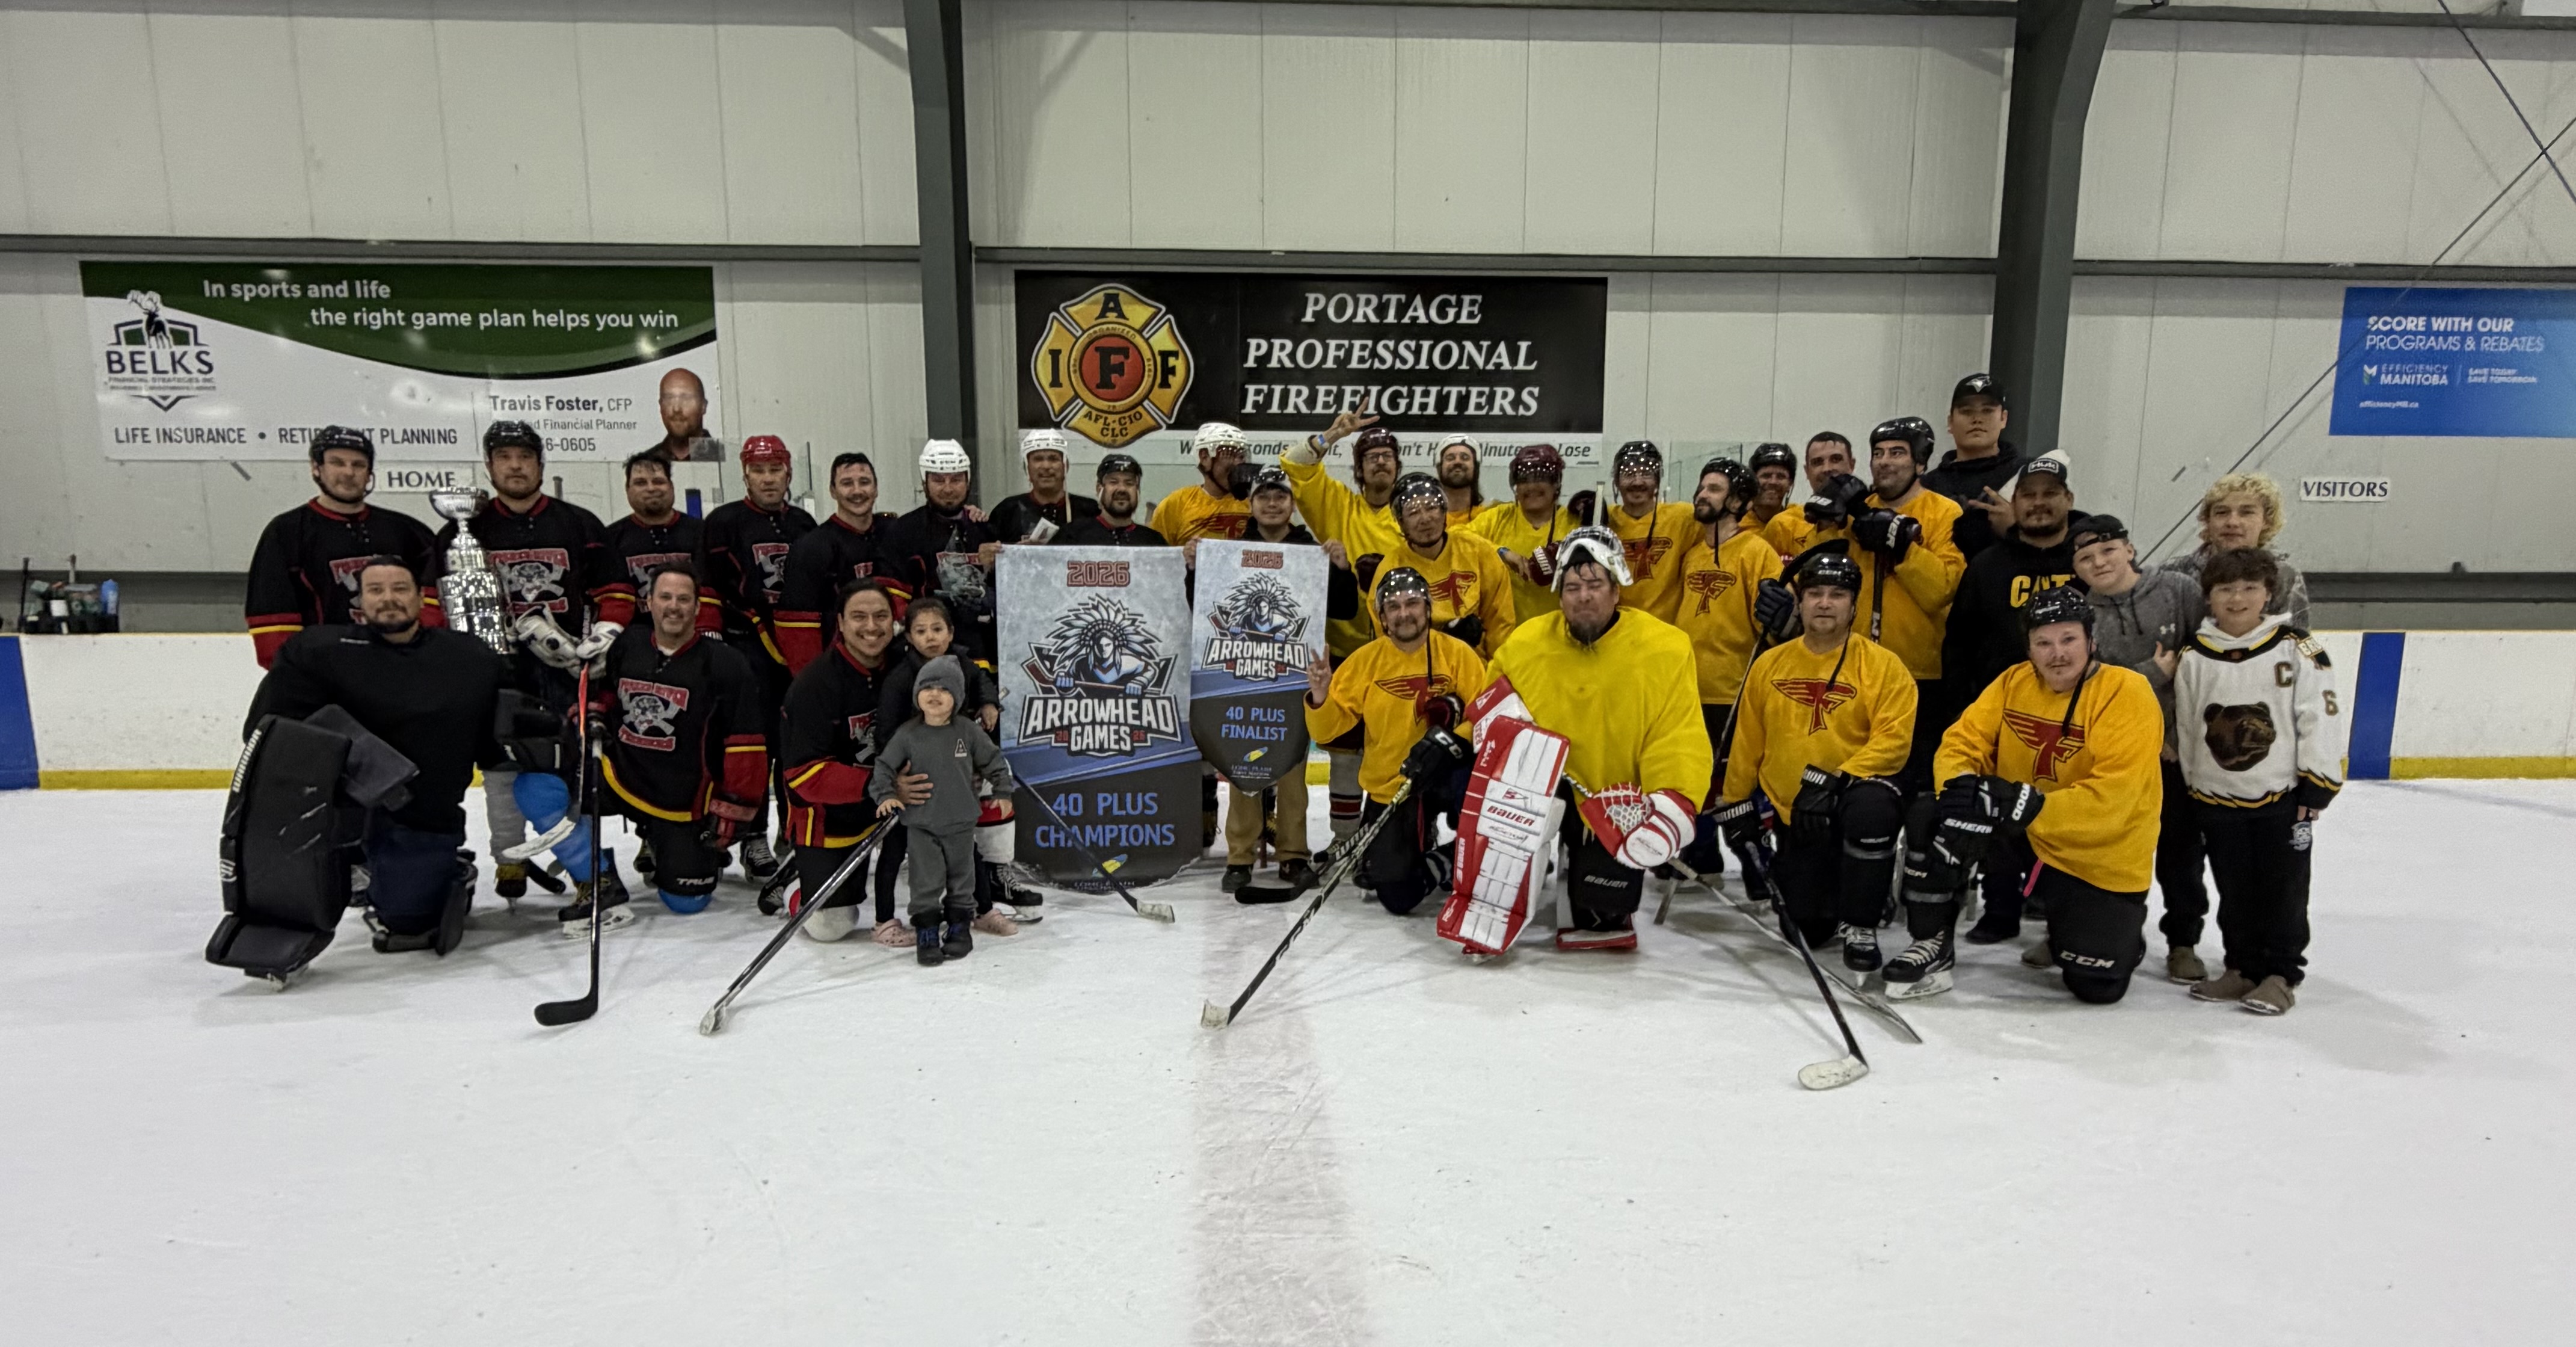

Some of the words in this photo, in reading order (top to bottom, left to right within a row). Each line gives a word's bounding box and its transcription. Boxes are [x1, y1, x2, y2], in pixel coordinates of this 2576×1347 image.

[204, 280, 224, 298] In
[232, 281, 301, 301] sports
[307, 280, 349, 298] and
[355, 280, 391, 298] life
[1095, 293, 1130, 321] A
[1302, 292, 1483, 324] PORTAGE
[311, 308, 347, 325] the
[354, 308, 405, 330] right
[411, 312, 472, 330] game
[479, 309, 526, 330] plan
[533, 309, 590, 331] helps
[595, 313, 635, 331] you
[640, 310, 678, 327] win
[2367, 316, 2426, 331] SCORE
[2432, 316, 2473, 332] WITH
[2477, 317, 2515, 333] OUR
[2365, 334, 2461, 351] PROGRAMS
[2465, 336, 2476, 351] &
[2480, 336, 2544, 353] REBATES
[106, 350, 214, 375] BELKS
[1243, 338, 1539, 371] PROFESSIONAL
[1048, 349, 1063, 388] I
[1095, 347, 1130, 389] F
[1158, 350, 1179, 389] F
[2381, 363, 2448, 373] EFFICIENCY
[2379, 374, 2448, 386] MANITOBA
[490, 395, 541, 411] Travis
[545, 395, 604, 413] Foster,
[608, 398, 633, 411] CFP
[1240, 383, 1540, 417] FIREFIGHTERS
[543, 418, 593, 430] Financial
[595, 419, 637, 430] Planner
[1100, 427, 1129, 438] CLC
[114, 428, 152, 444] LIFE
[157, 428, 247, 445] INSURANCE
[380, 429, 458, 445] PLANNING
[387, 471, 456, 489] HOME
[2303, 481, 2388, 498] VISITORS
[1241, 549, 1283, 570] 2026
[1067, 560, 1131, 587] 2026
[1209, 640, 1307, 670] ARROWHEAD
[1235, 659, 1276, 679] GAMES
[2273, 661, 2293, 688] C
[2322, 689, 2338, 716] 6
[1024, 696, 1176, 737] ARROWHEAD
[1226, 706, 1244, 723] 40
[1250, 708, 1285, 723] PLUS
[1070, 724, 1131, 751] GAMES
[1221, 724, 1288, 742] FINALIST
[1053, 793, 1083, 817] 40
[1097, 792, 1158, 816] PLUS
[1487, 806, 1535, 827] BAUER
[1034, 823, 1175, 848] CHAMPIONS
[2060, 949, 2115, 969] CCM
